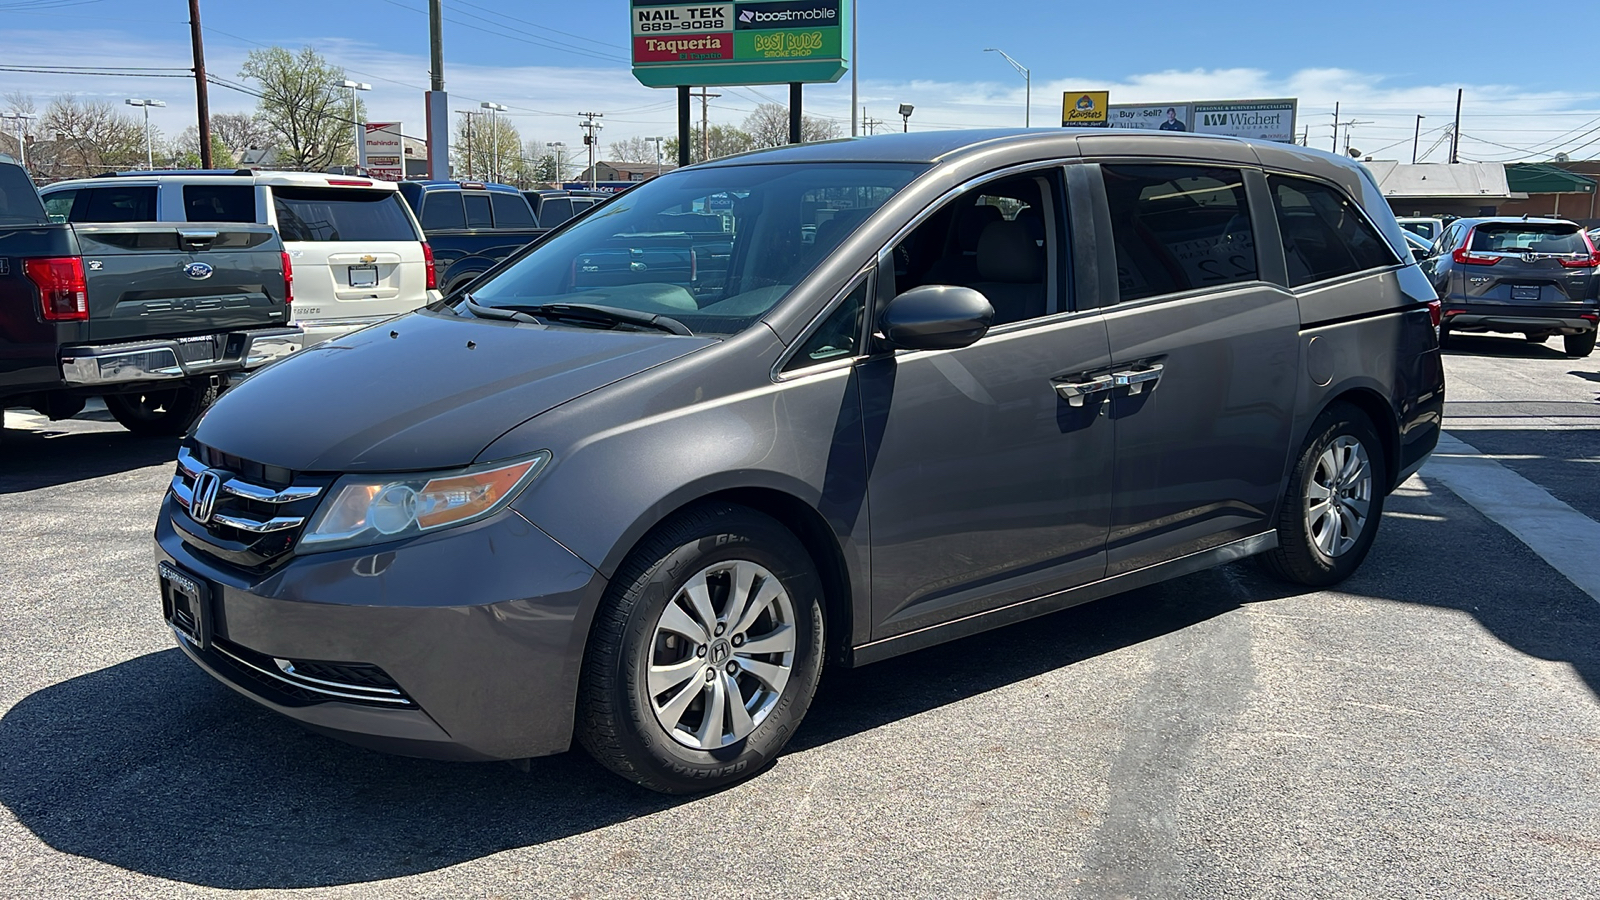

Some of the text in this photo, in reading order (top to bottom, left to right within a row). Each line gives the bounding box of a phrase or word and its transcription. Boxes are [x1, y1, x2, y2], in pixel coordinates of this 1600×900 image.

[639, 7, 725, 21] NAIL TEK
[641, 20, 724, 31] 689-9088
[764, 49, 812, 58] SMOKE SHOP
[1120, 111, 1135, 119] Buy
[1230, 112, 1281, 125] Wichert
[191, 265, 208, 276] Ford
[662, 755, 748, 779] GENERAL
